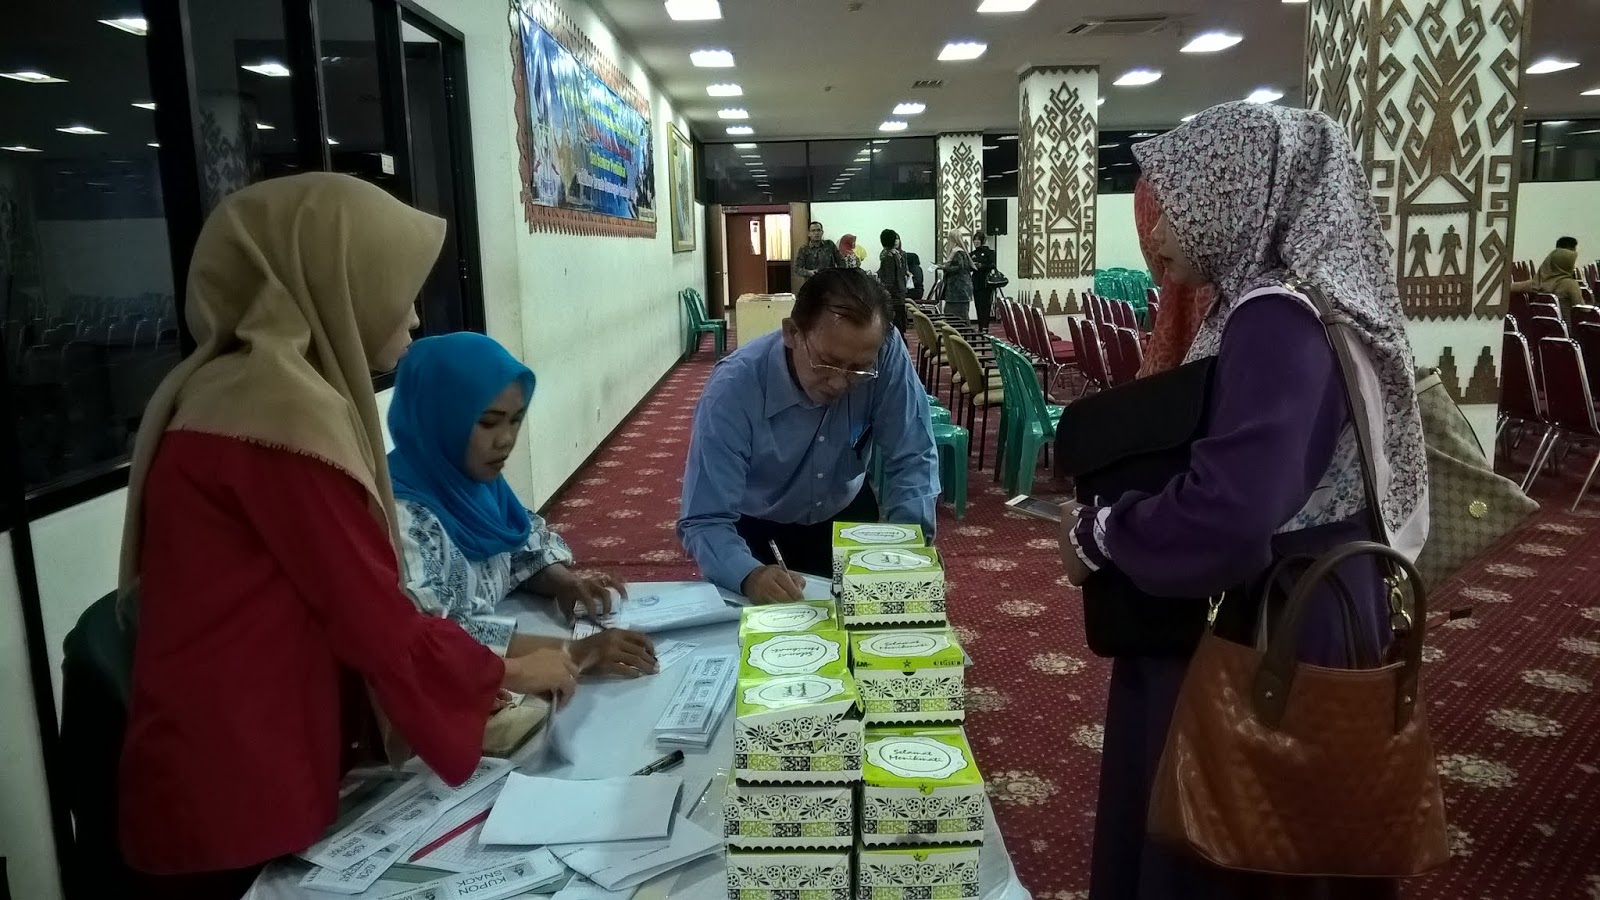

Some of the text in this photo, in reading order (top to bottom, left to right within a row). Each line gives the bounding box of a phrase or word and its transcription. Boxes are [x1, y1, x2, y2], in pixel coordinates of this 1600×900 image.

[889, 754, 944, 763] Menikmati
[893, 748, 933, 756] Selamat
[455, 869, 503, 887] SNACK
[458, 876, 507, 896] KUPON
